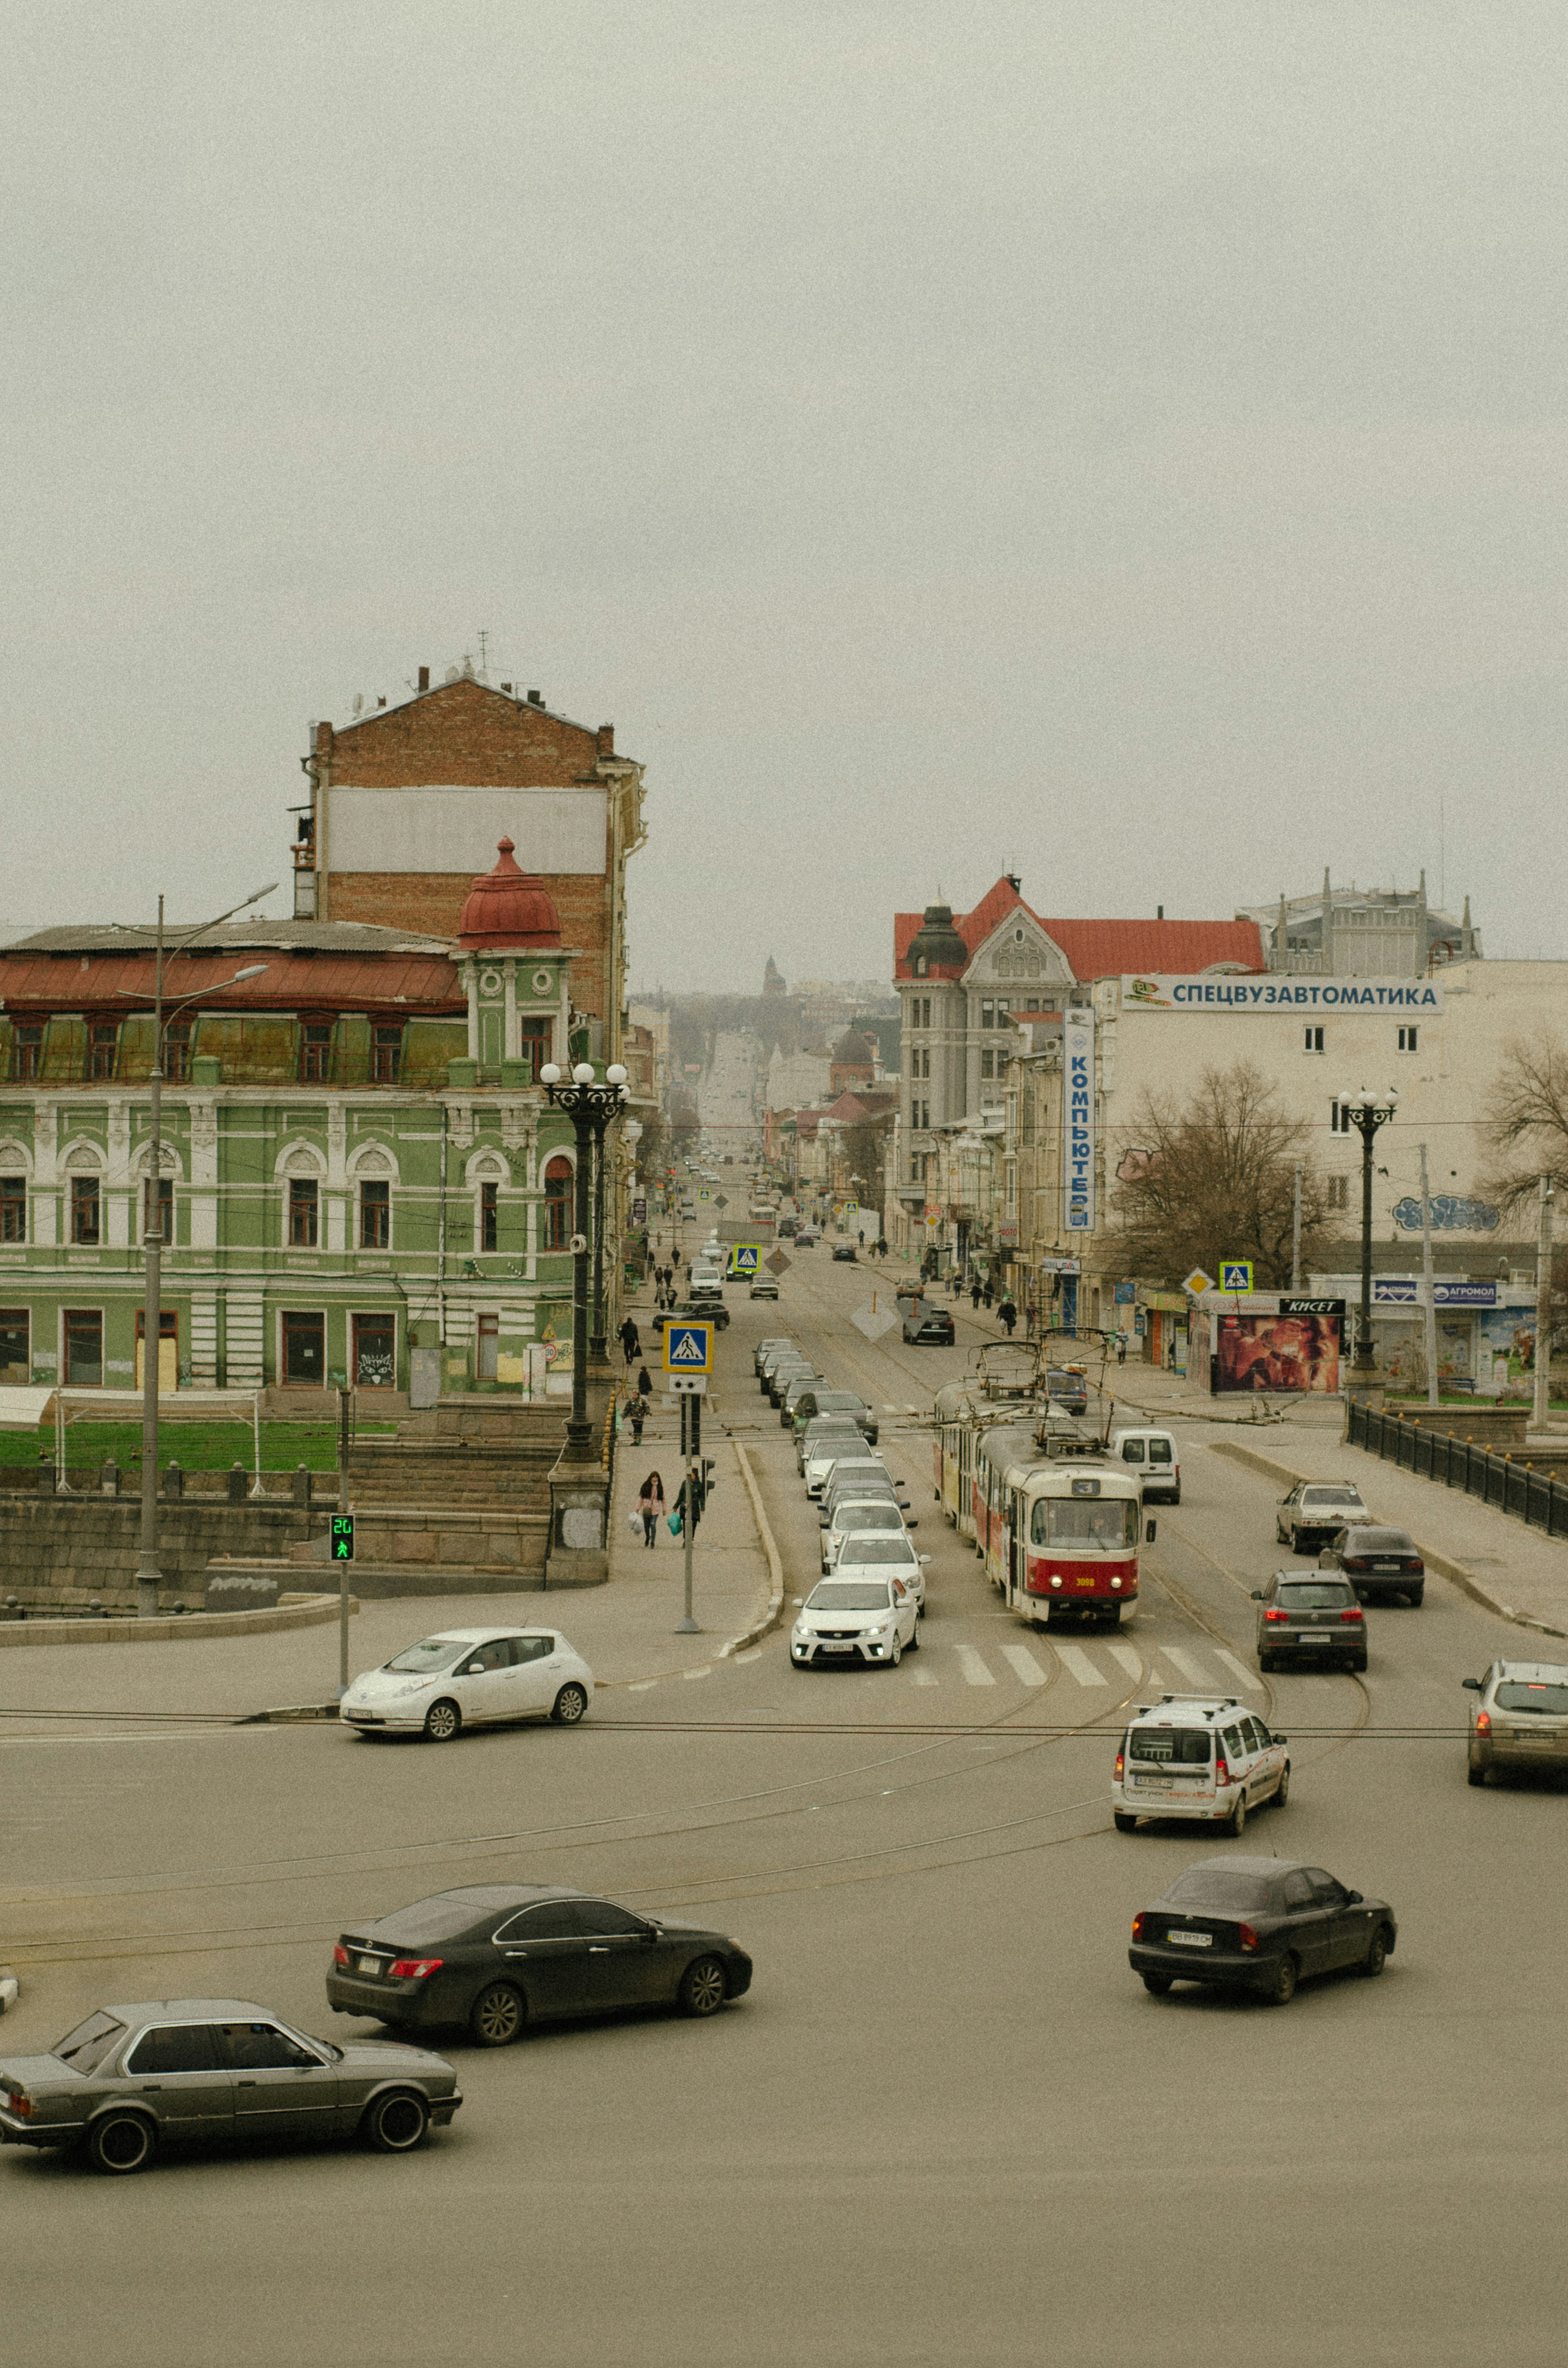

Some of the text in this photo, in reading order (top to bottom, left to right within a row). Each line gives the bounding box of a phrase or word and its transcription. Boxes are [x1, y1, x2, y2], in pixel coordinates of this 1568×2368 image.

[1173, 984, 1437, 1005] СПЕЦВУЗАВТОМАТИКА
[1001, 1228, 1017, 1236] ФОТО
[1450, 1287, 1494, 1296] АГРОМОЛ
[1289, 1301, 1336, 1311] КИСЕТ
[1078, 1482, 1092, 1493] 3
[334, 1519, 351, 1533] 20
[1077, 1578, 1095, 1586] 3098
[1127, 1788, 1164, 1797] Порятунок
